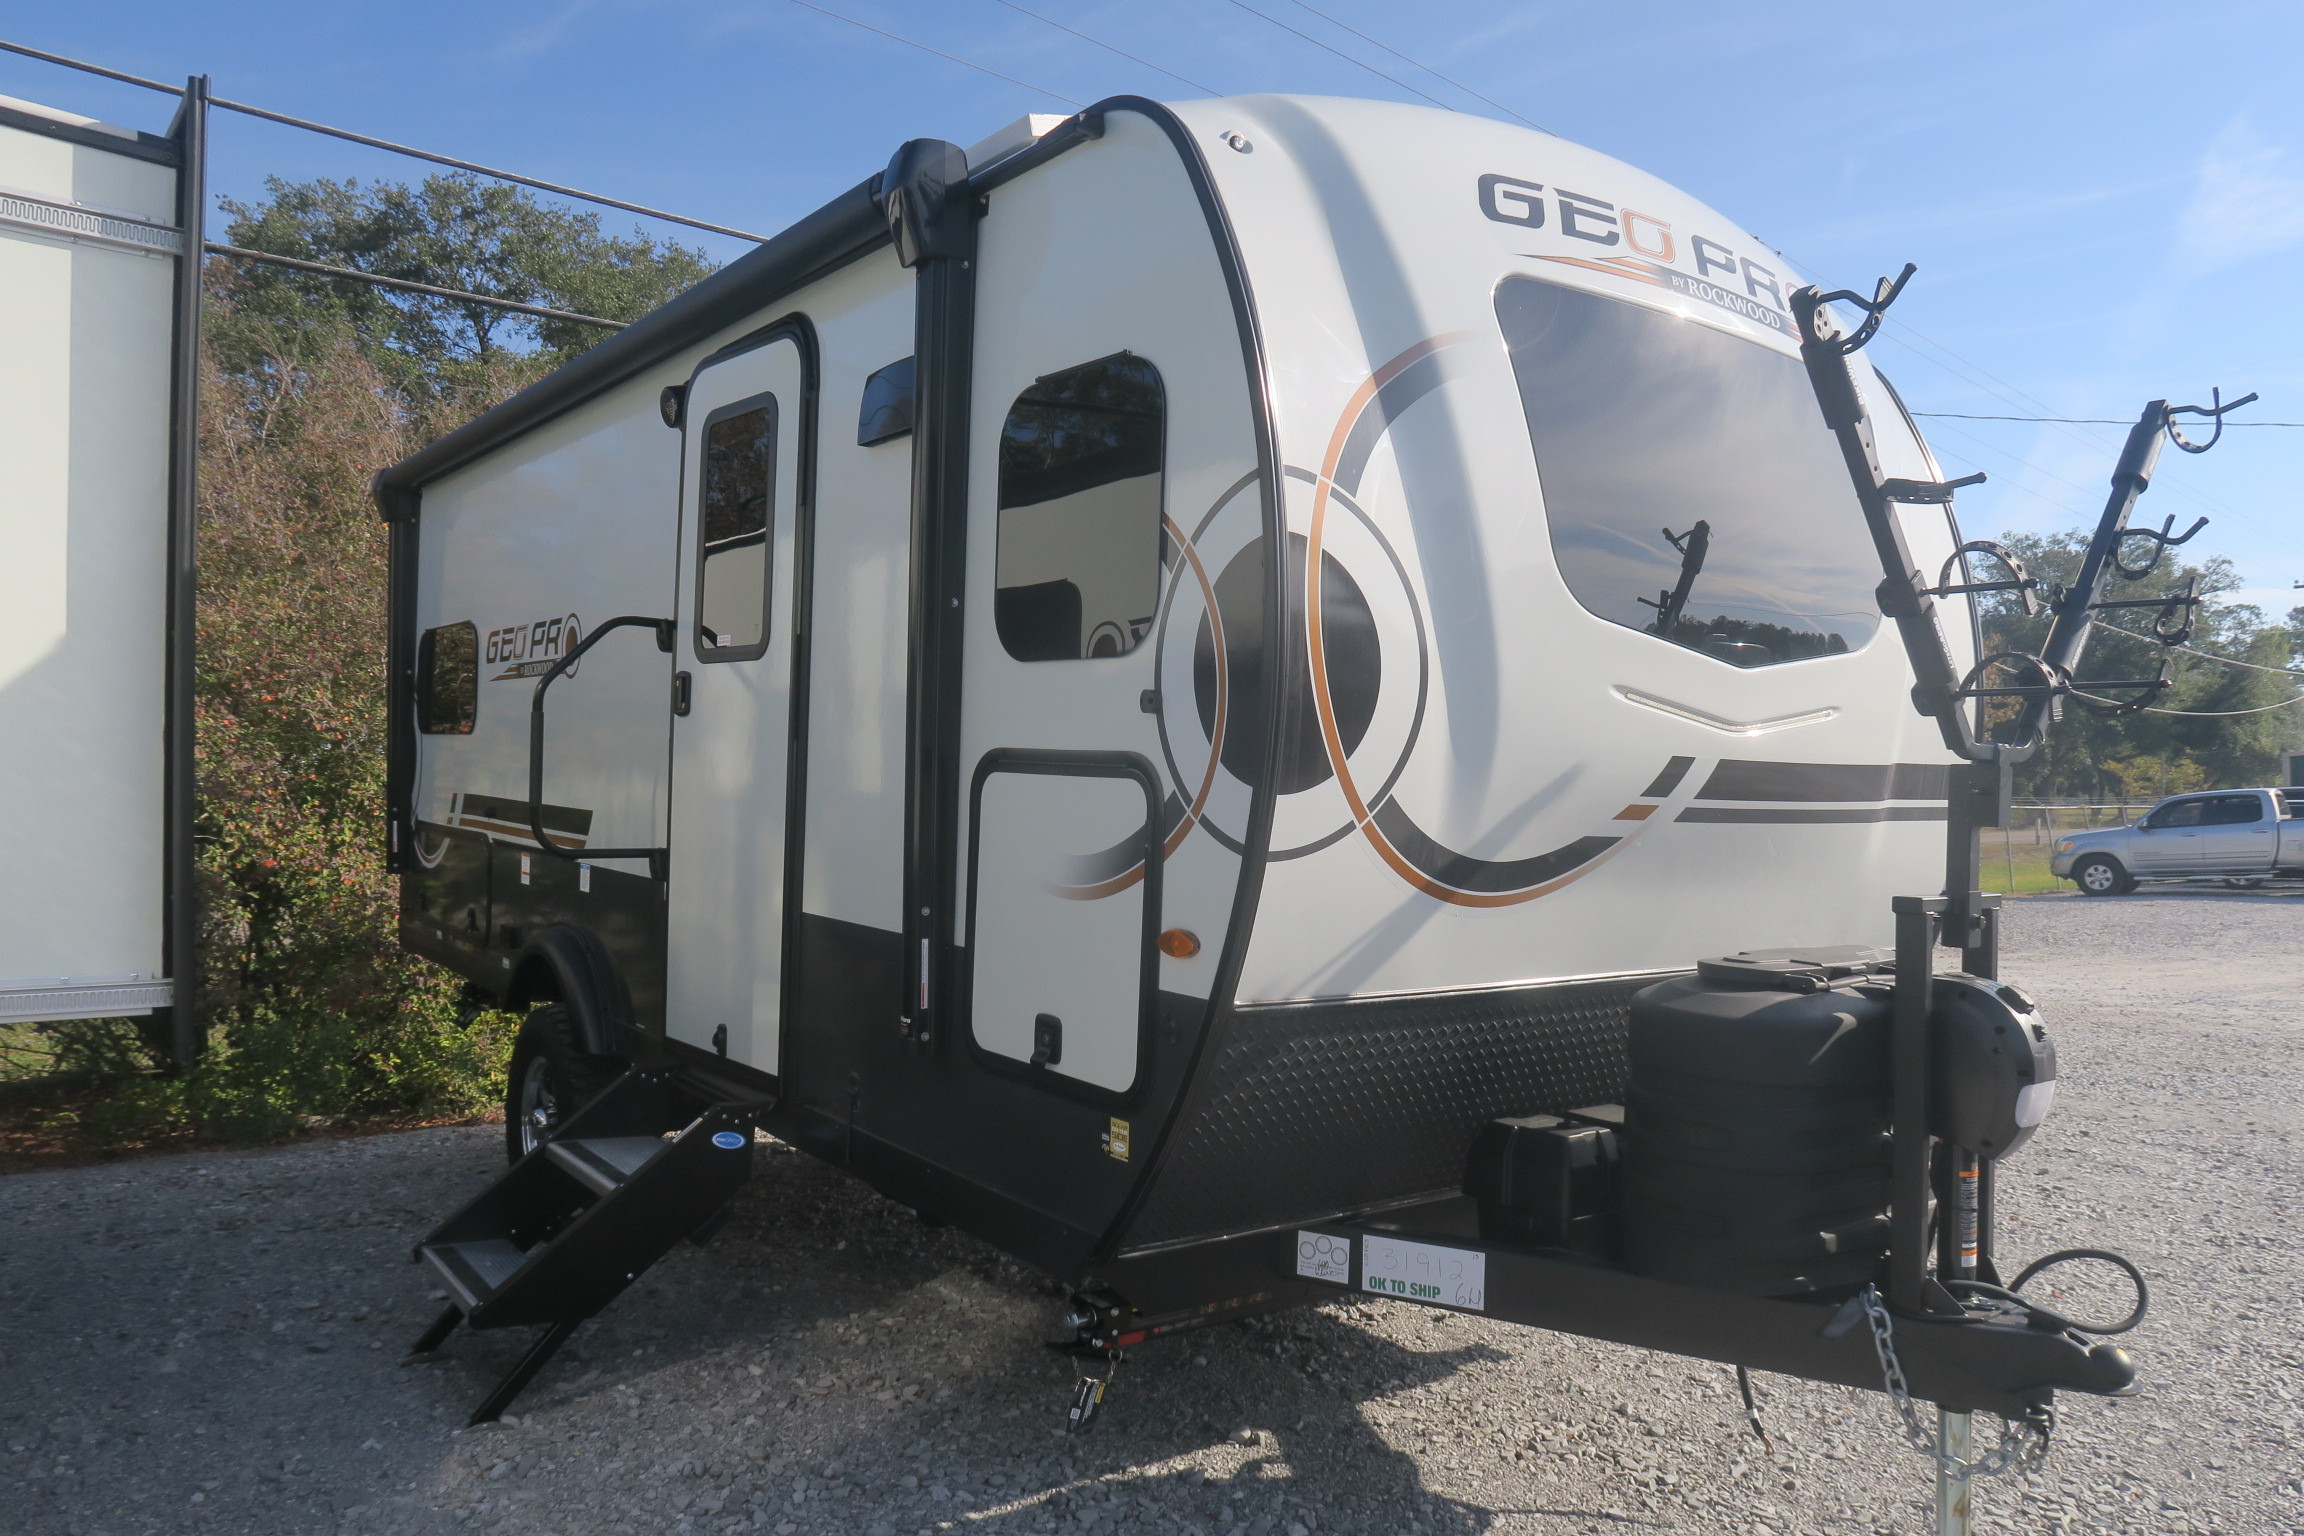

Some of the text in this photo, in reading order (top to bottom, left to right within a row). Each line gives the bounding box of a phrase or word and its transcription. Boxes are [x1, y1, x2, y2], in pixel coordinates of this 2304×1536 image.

[1478, 173, 1799, 313] GEO PR
[1671, 275, 1781, 330] BY ROCKWOOD
[486, 624, 529, 664] GEO
[1111, 1131, 1128, 1143] SIDE
[1369, 1275, 1441, 1299] OK TO SHIP
